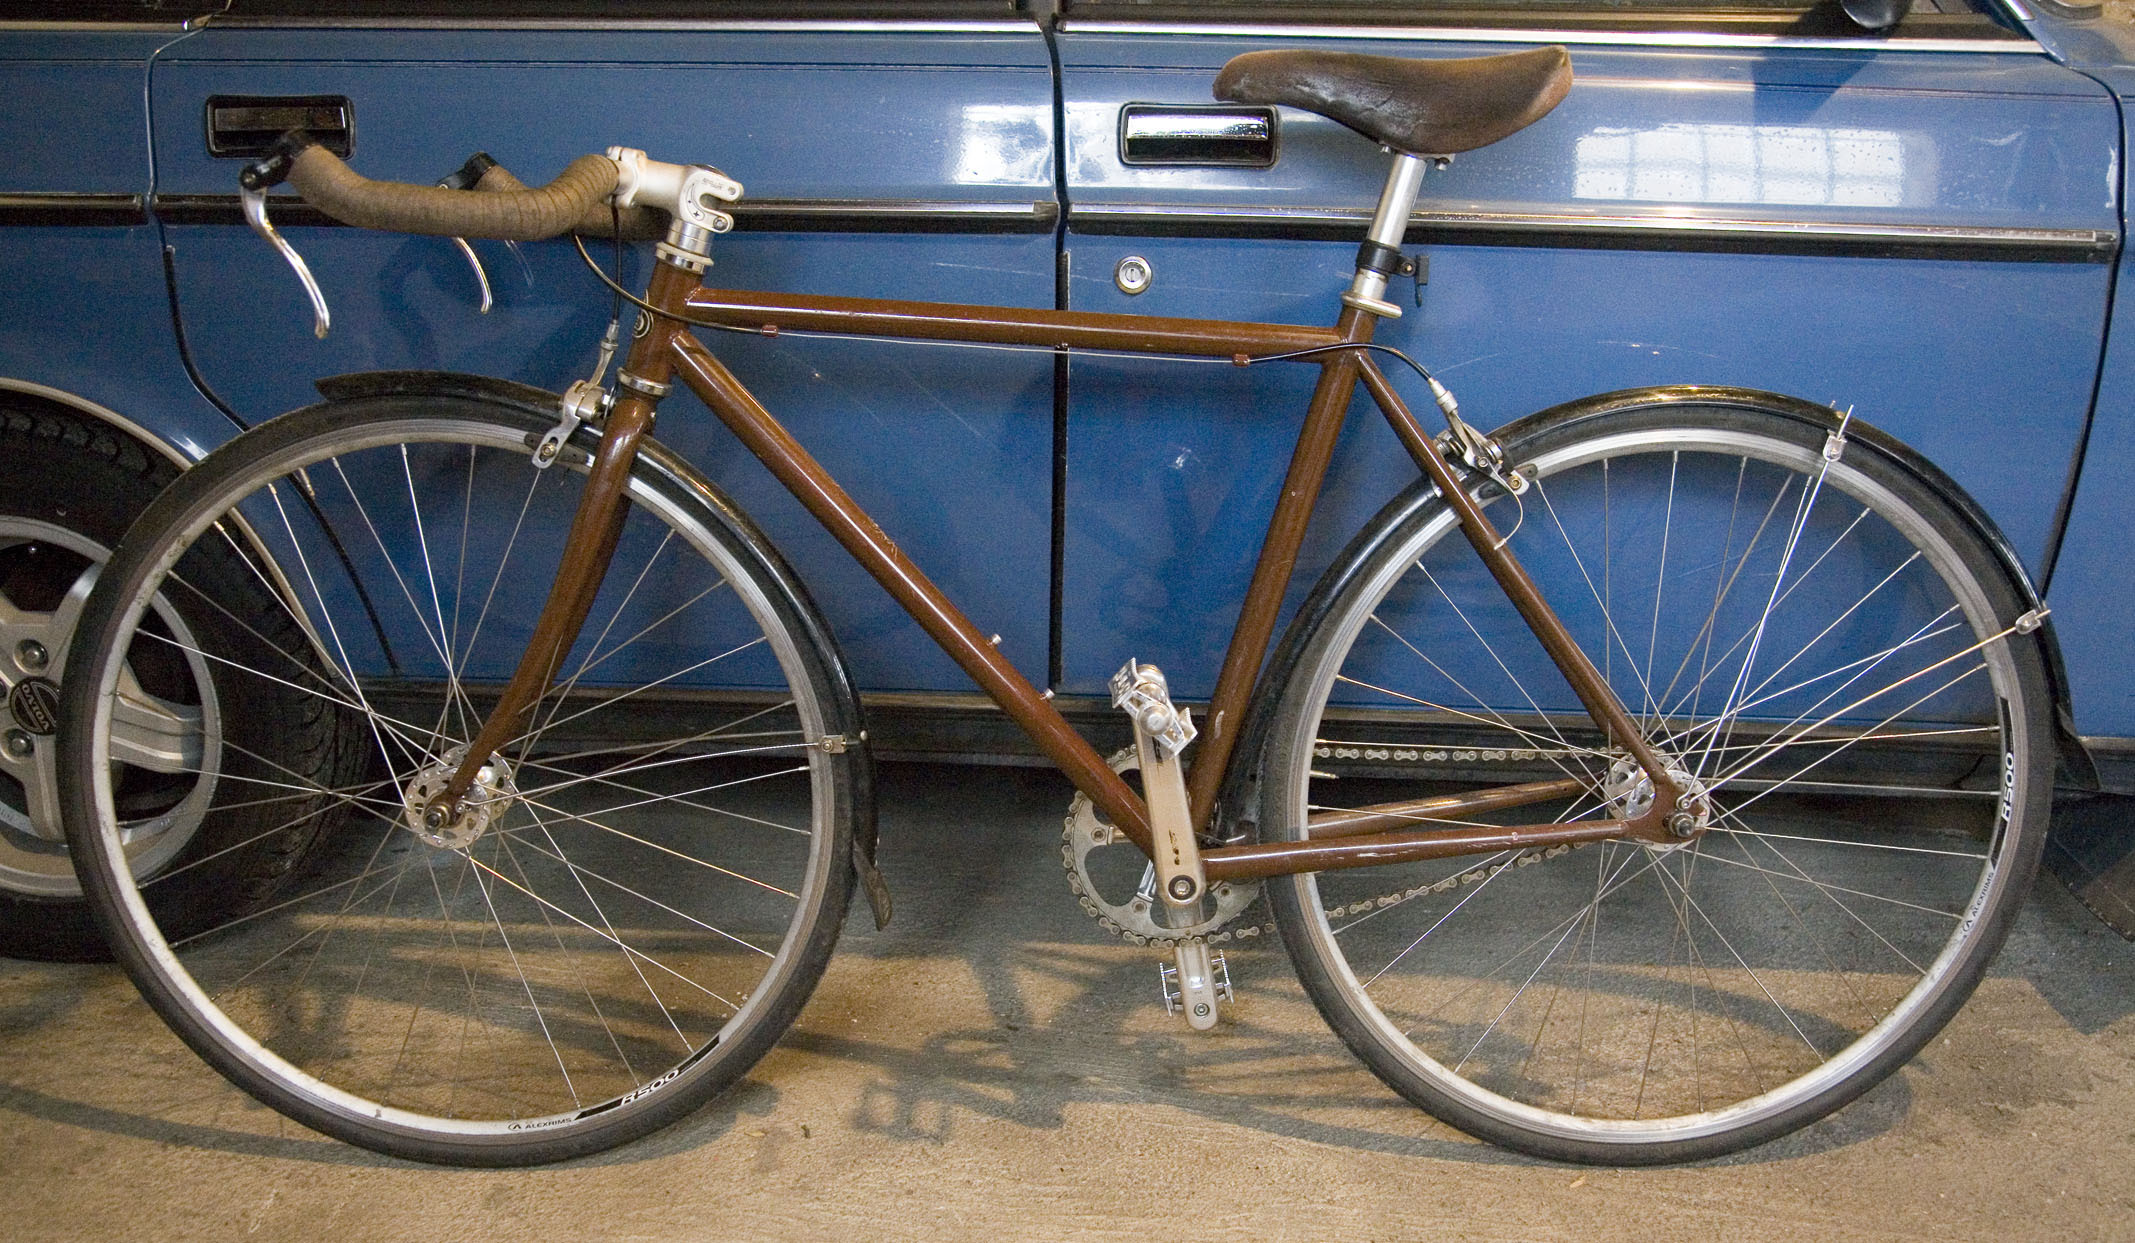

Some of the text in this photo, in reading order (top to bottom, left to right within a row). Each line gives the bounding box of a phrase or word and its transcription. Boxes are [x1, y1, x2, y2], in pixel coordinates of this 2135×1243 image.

[22, 683, 50, 731] VOLVO
[2001, 752, 2015, 822] R500
[1971, 872, 1995, 917] ALEXRIMS
[620, 1069, 680, 1106] R500
[525, 1117, 572, 1130] ALEXRIMS
